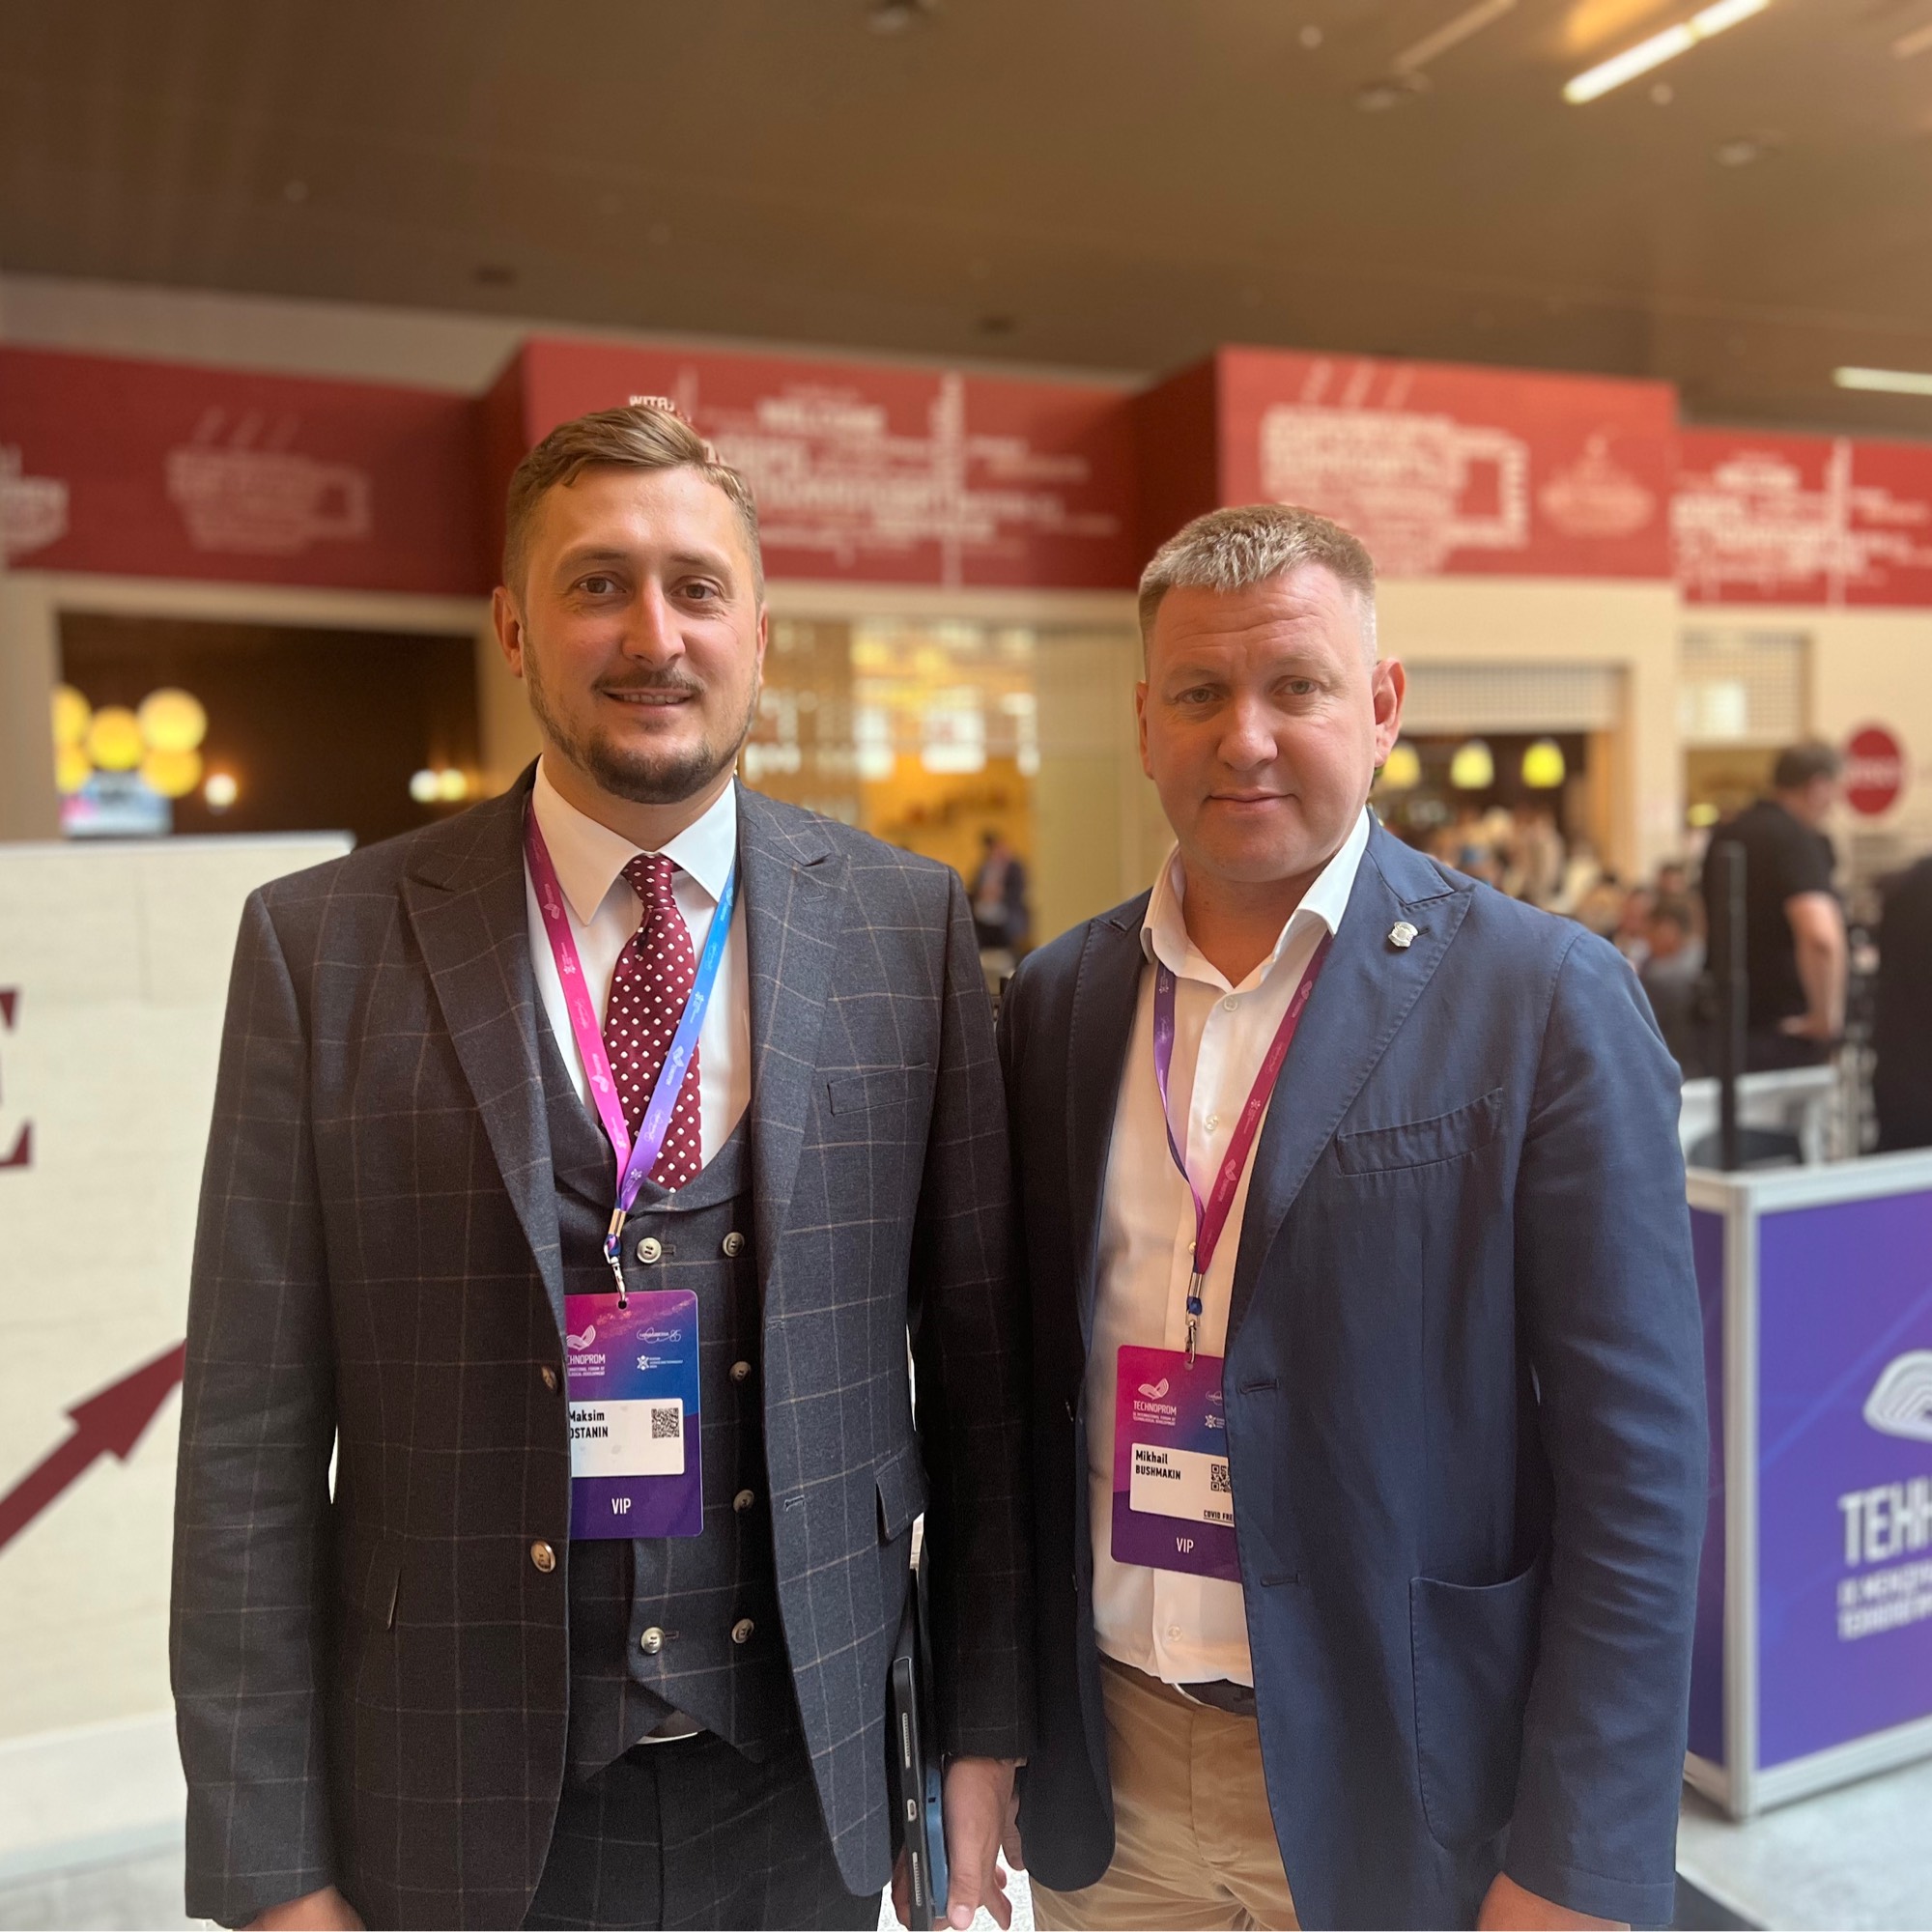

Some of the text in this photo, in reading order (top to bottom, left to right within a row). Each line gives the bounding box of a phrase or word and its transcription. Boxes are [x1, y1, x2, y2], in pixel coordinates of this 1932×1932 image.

[1133, 1400, 1177, 1415] TECHNOPROM
[570, 1409, 605, 1422] Maksim
[1135, 1449, 1168, 1464] Mikhail
[1135, 1464, 1181, 1480] BUSHMAKIN
[611, 1498, 632, 1515] VIP
[1176, 1537, 1194, 1553] VIP
